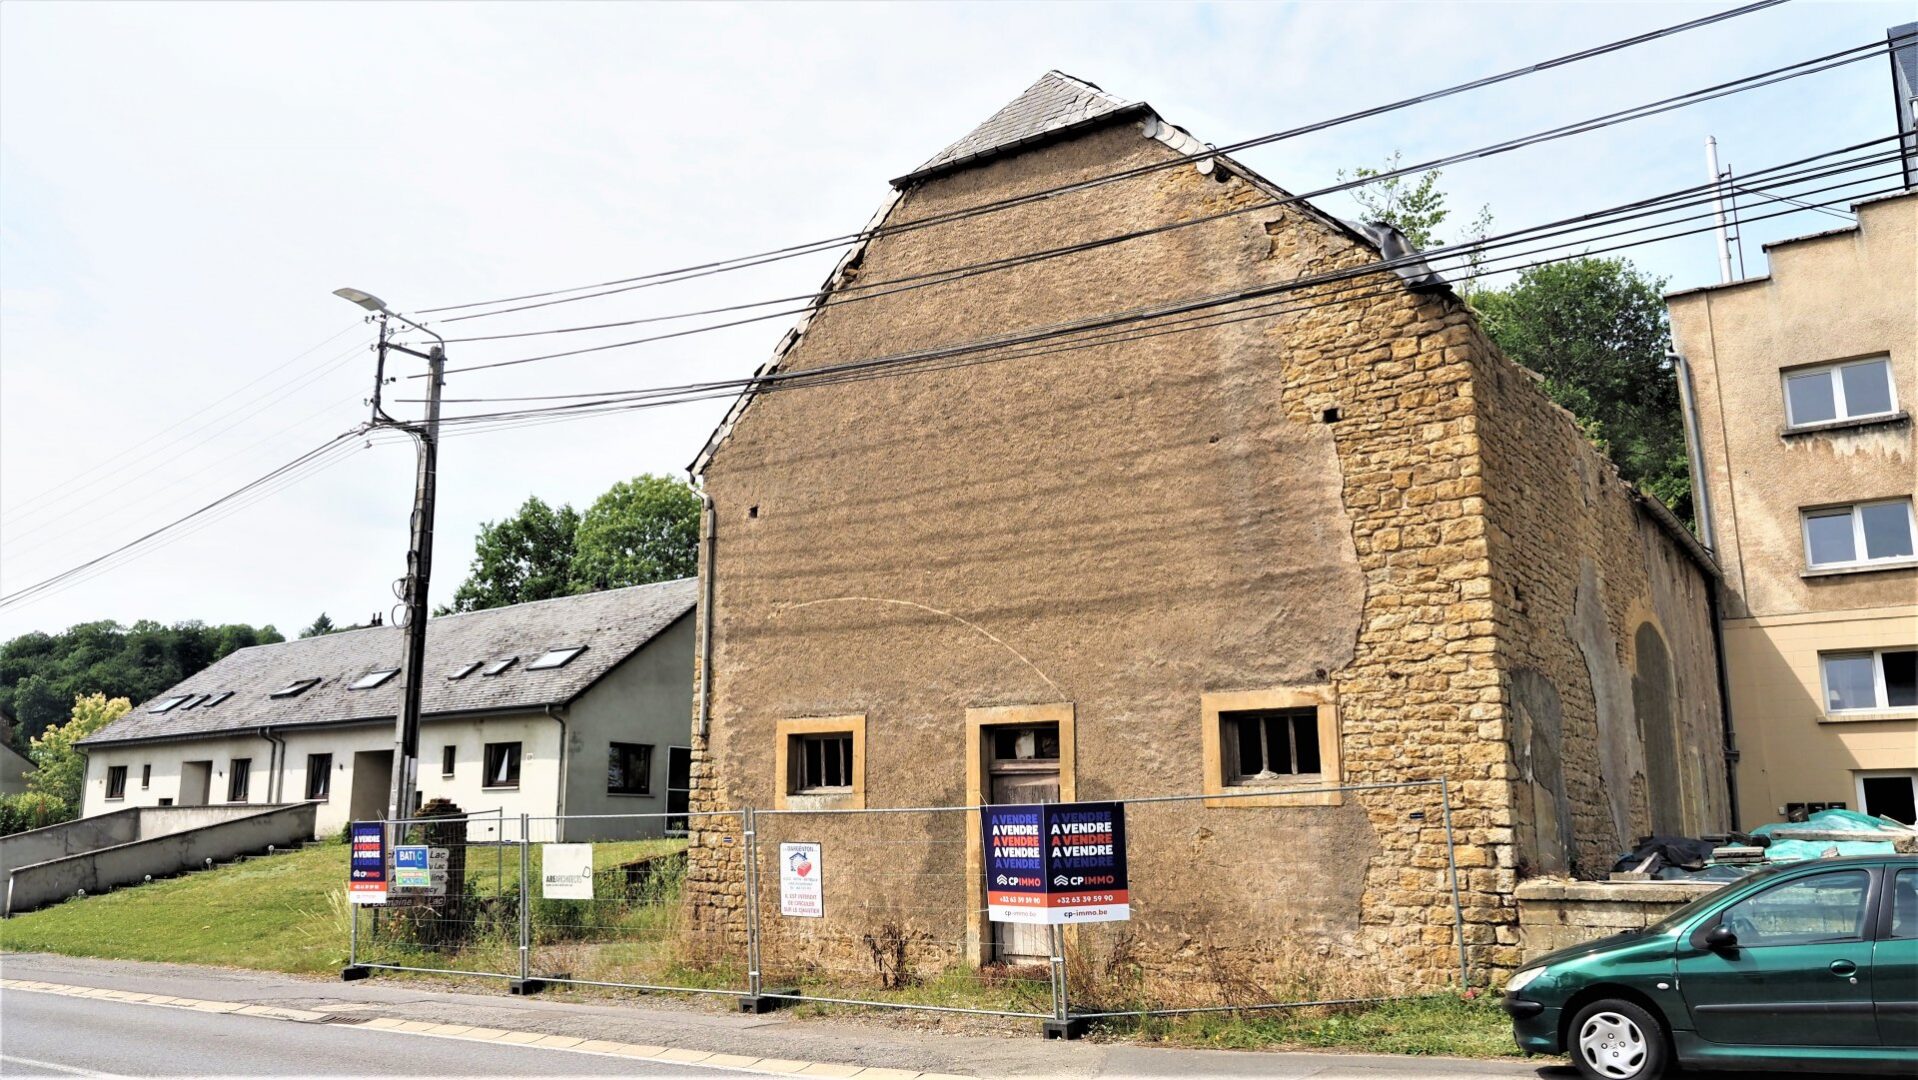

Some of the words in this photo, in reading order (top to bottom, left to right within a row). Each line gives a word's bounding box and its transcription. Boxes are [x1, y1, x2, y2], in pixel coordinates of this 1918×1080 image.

[992, 816, 999, 825] A
[1000, 814, 1038, 824] VENDRE
[1051, 814, 1060, 824] A
[1061, 812, 1112, 823] VENDRE
[993, 826, 1000, 835] A
[1000, 825, 1038, 835] VENDRE
[1051, 824, 1060, 835] A
[1062, 822, 1112, 834] VENDRE
[994, 837, 1001, 846] A
[1001, 836, 1039, 846] VENDRE
[1052, 836, 1061, 846] A
[1062, 834, 1112, 846] VENDRE
[995, 848, 1002, 857] A
[1002, 847, 1039, 857] VENDRE
[1052, 847, 1061, 857] A
[1063, 845, 1113, 856] VENDRE
[996, 859, 1003, 868] A
[1003, 858, 1040, 869] VENDRE
[1053, 859, 1062, 869] A
[1064, 857, 1114, 868] VENDRE
